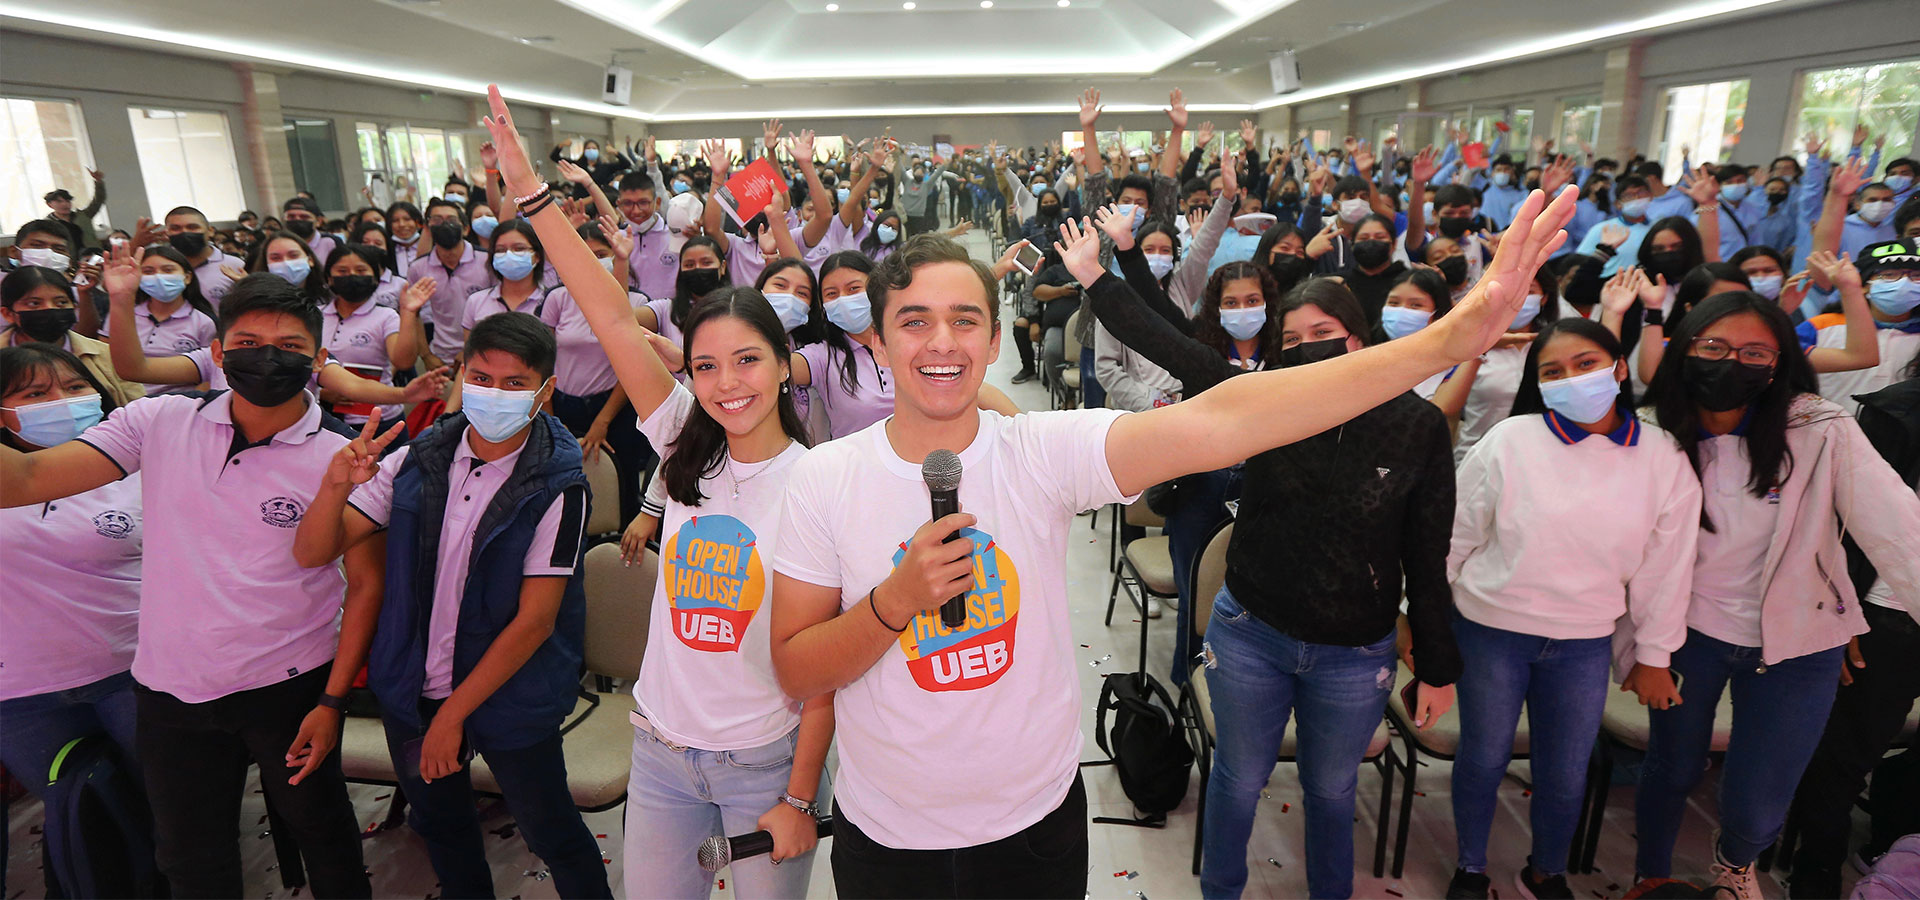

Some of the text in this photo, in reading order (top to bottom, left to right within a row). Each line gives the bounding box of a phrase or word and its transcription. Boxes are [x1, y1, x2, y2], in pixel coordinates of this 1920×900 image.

[686, 538, 741, 576] OPEN
[676, 568, 741, 609] HOUSE
[680, 612, 736, 644] UEB
[930, 640, 1009, 684] UEB
